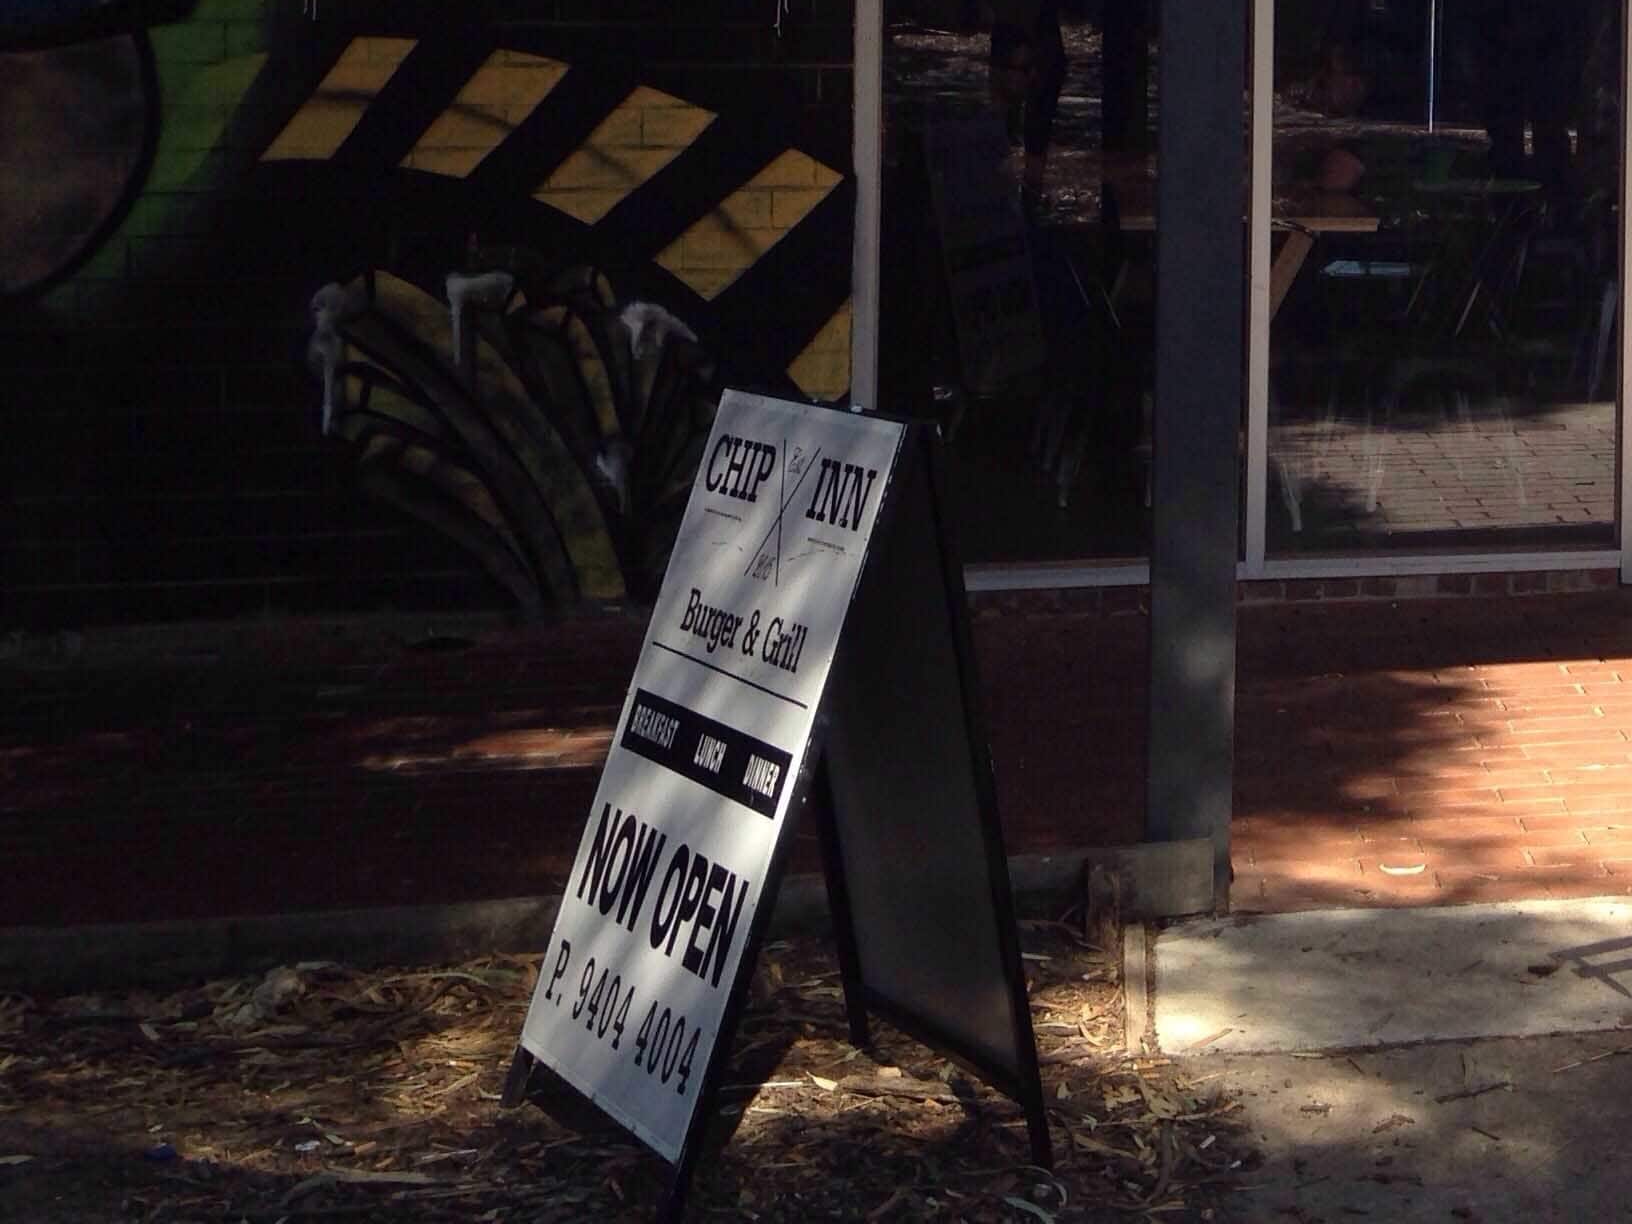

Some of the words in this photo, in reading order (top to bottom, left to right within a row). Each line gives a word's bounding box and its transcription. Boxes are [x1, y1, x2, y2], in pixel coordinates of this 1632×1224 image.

[705, 434, 776, 503] CHIP
[805, 458, 877, 531] INN
[680, 588, 744, 654] Burger
[741, 610, 760, 657] &
[762, 617, 808, 674] Grill
[630, 704, 680, 750] BREAKFAST
[693, 733, 728, 773] LUNCH
[742, 754, 781, 798] DINNER
[577, 803, 666, 932] NOW
[650, 844, 750, 988] OPEN
[545, 940, 571, 1007] P.
[572, 957, 636, 1051] 9404
[634, 1000, 702, 1095] 4004
